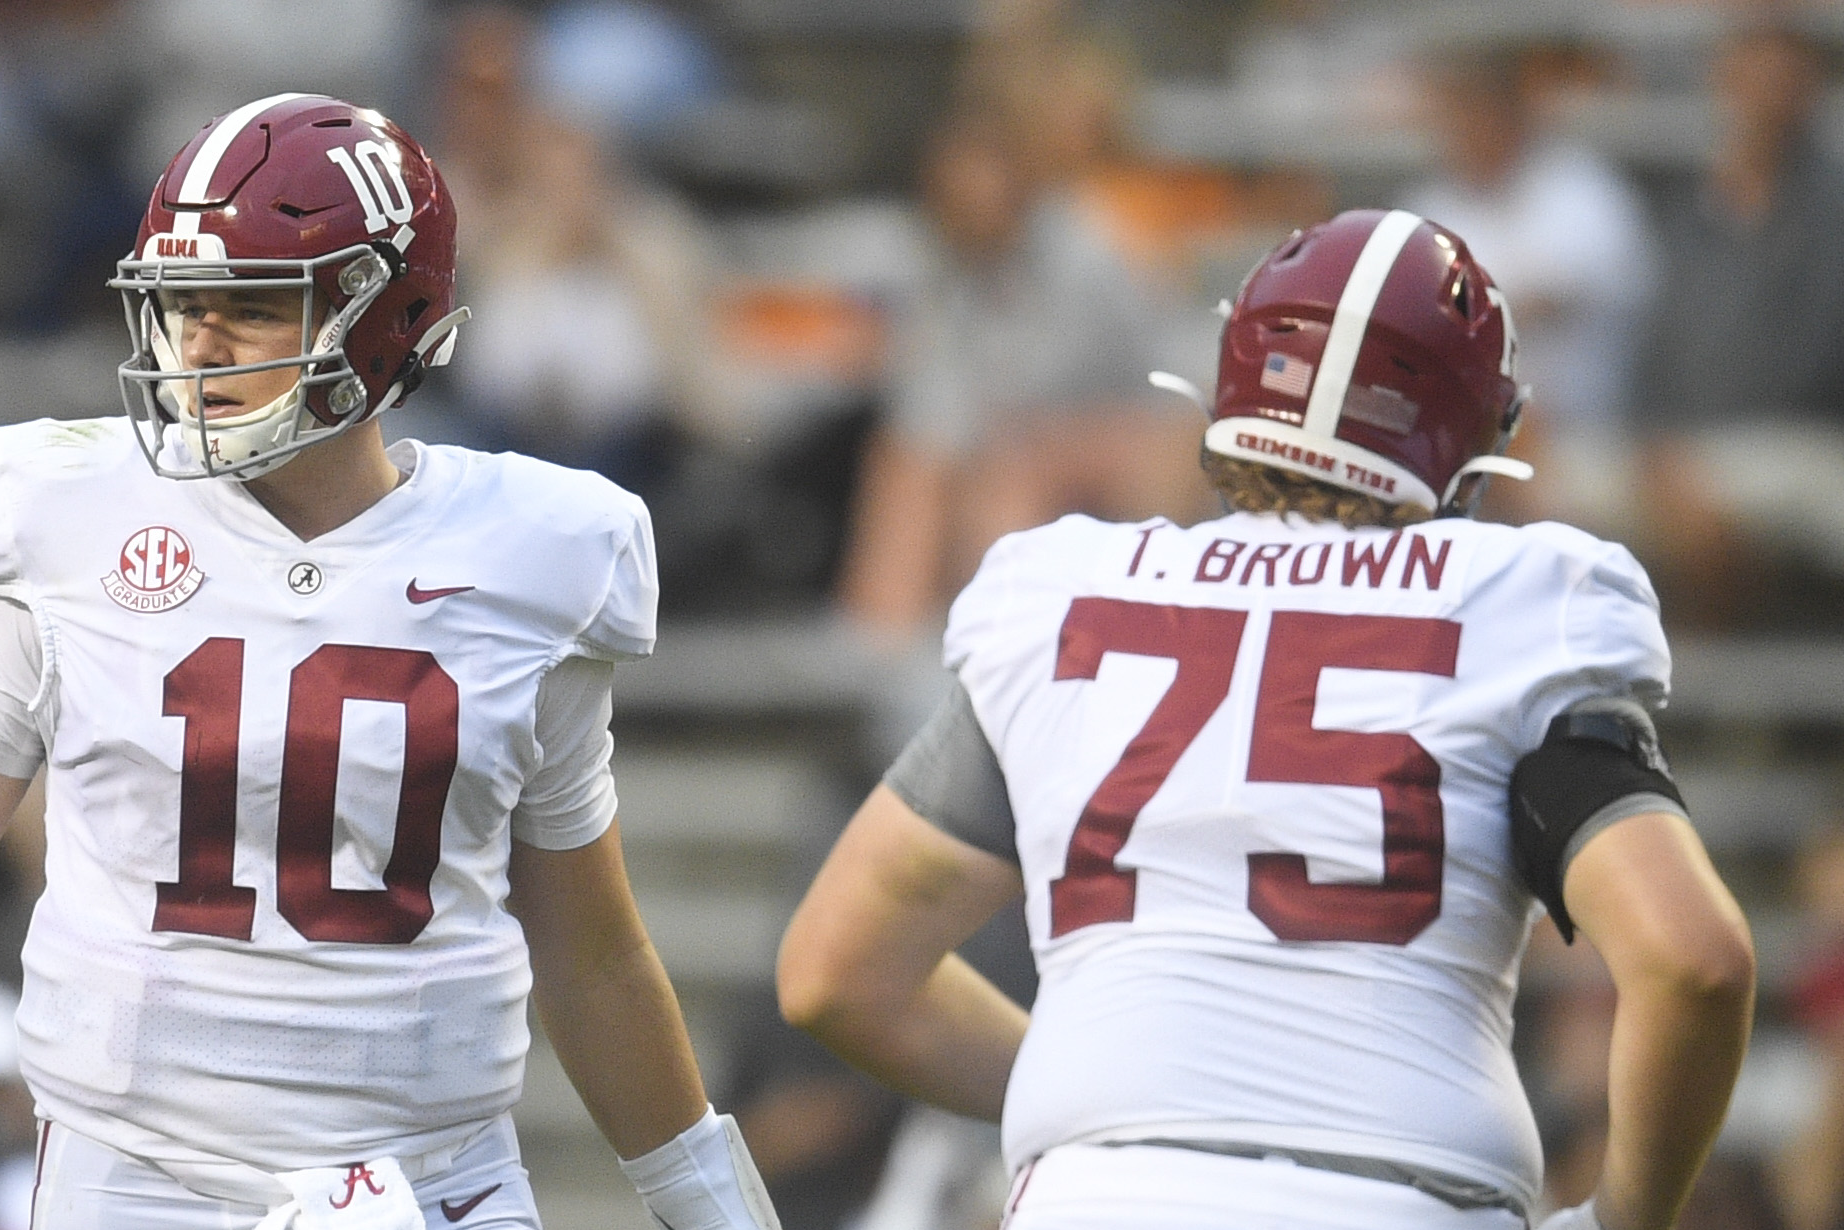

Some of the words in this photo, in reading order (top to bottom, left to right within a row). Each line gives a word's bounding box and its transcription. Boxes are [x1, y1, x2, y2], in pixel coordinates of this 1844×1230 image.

[325, 139, 414, 235] 10
[156, 237, 198, 259] BAMA
[1235, 432, 1336, 473] CRIMSON
[1345, 462, 1396, 495] TIDE
[122, 527, 188, 590] SEC
[1127, 524, 1166, 580] T.
[1193, 527, 1453, 592] BROWN
[112, 582, 191, 610] GRADUATE
[151, 636, 460, 945] 10
[1049, 595, 1462, 946] 75
